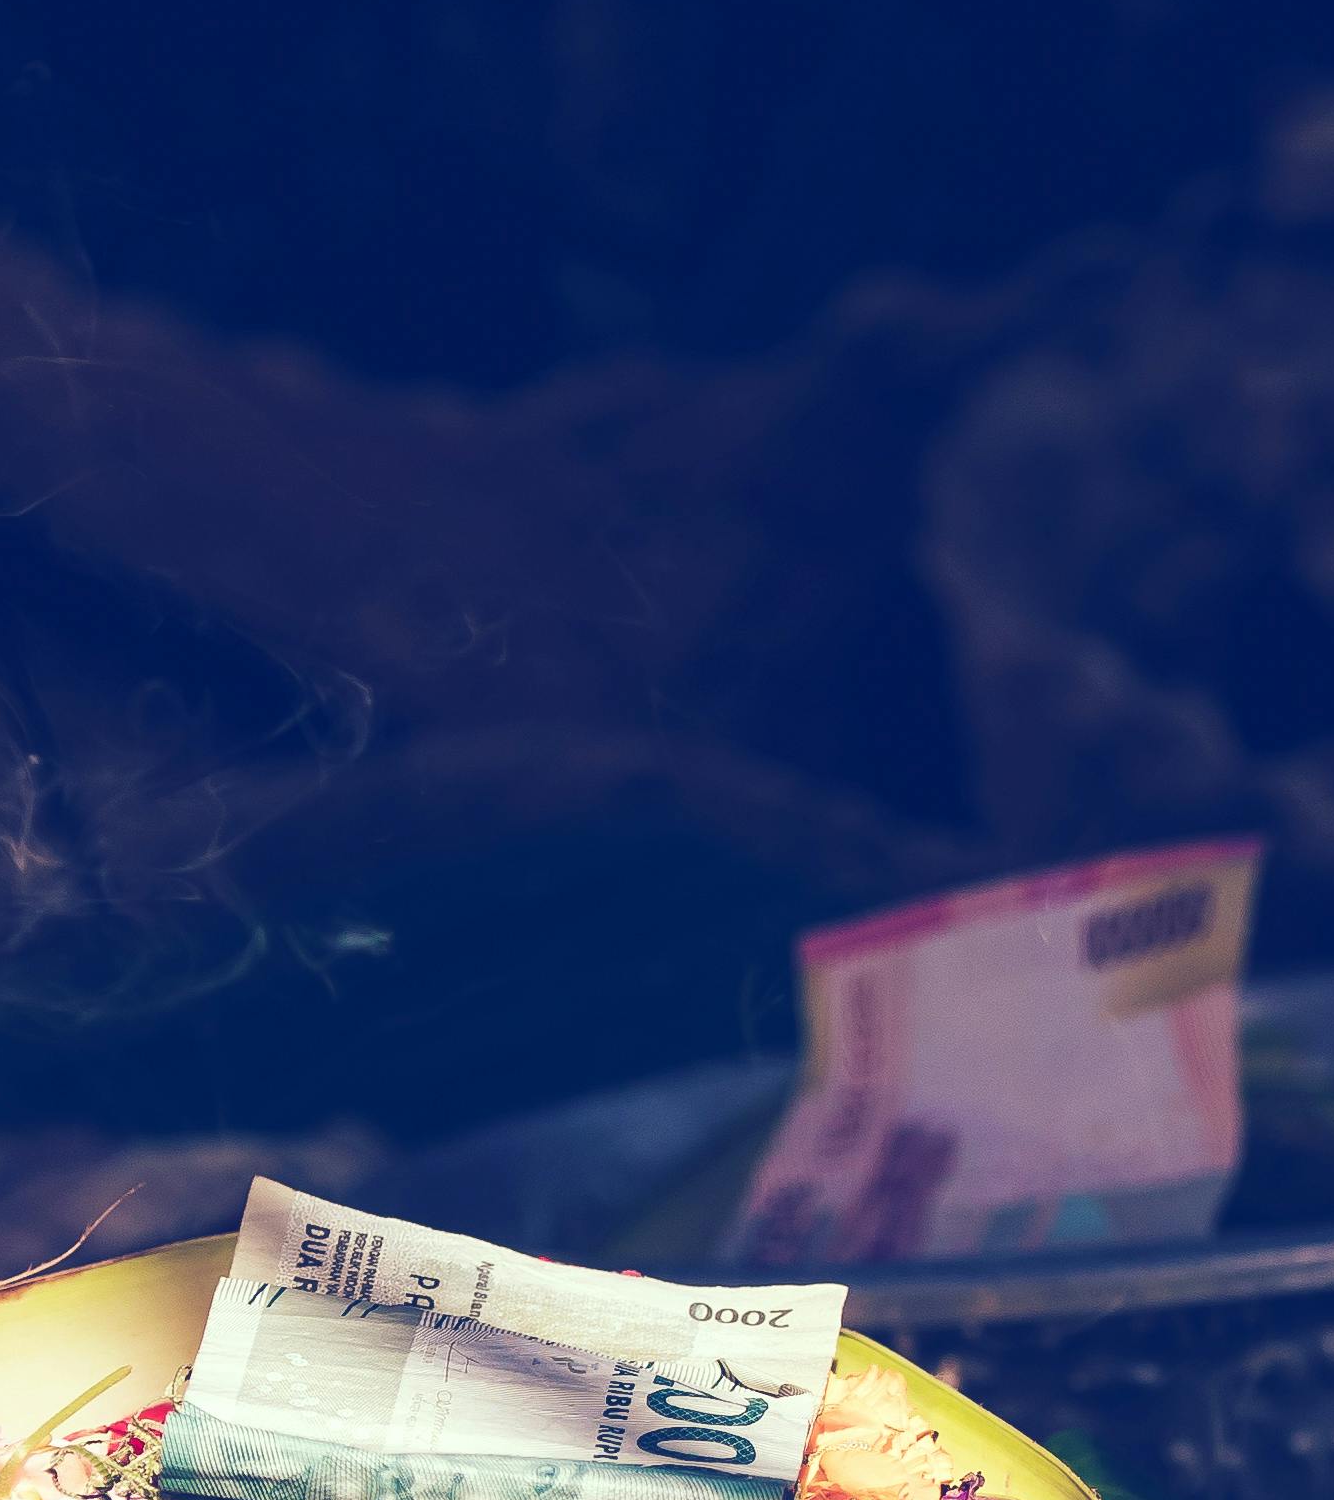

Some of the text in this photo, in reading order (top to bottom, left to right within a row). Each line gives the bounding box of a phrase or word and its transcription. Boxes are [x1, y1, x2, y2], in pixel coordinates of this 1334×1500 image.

[296, 1223, 331, 1268] DUA
[688, 1302, 794, 1329] 2000
[603, 1380, 634, 1420] RIBU
[593, 1424, 626, 1460] RUPI
